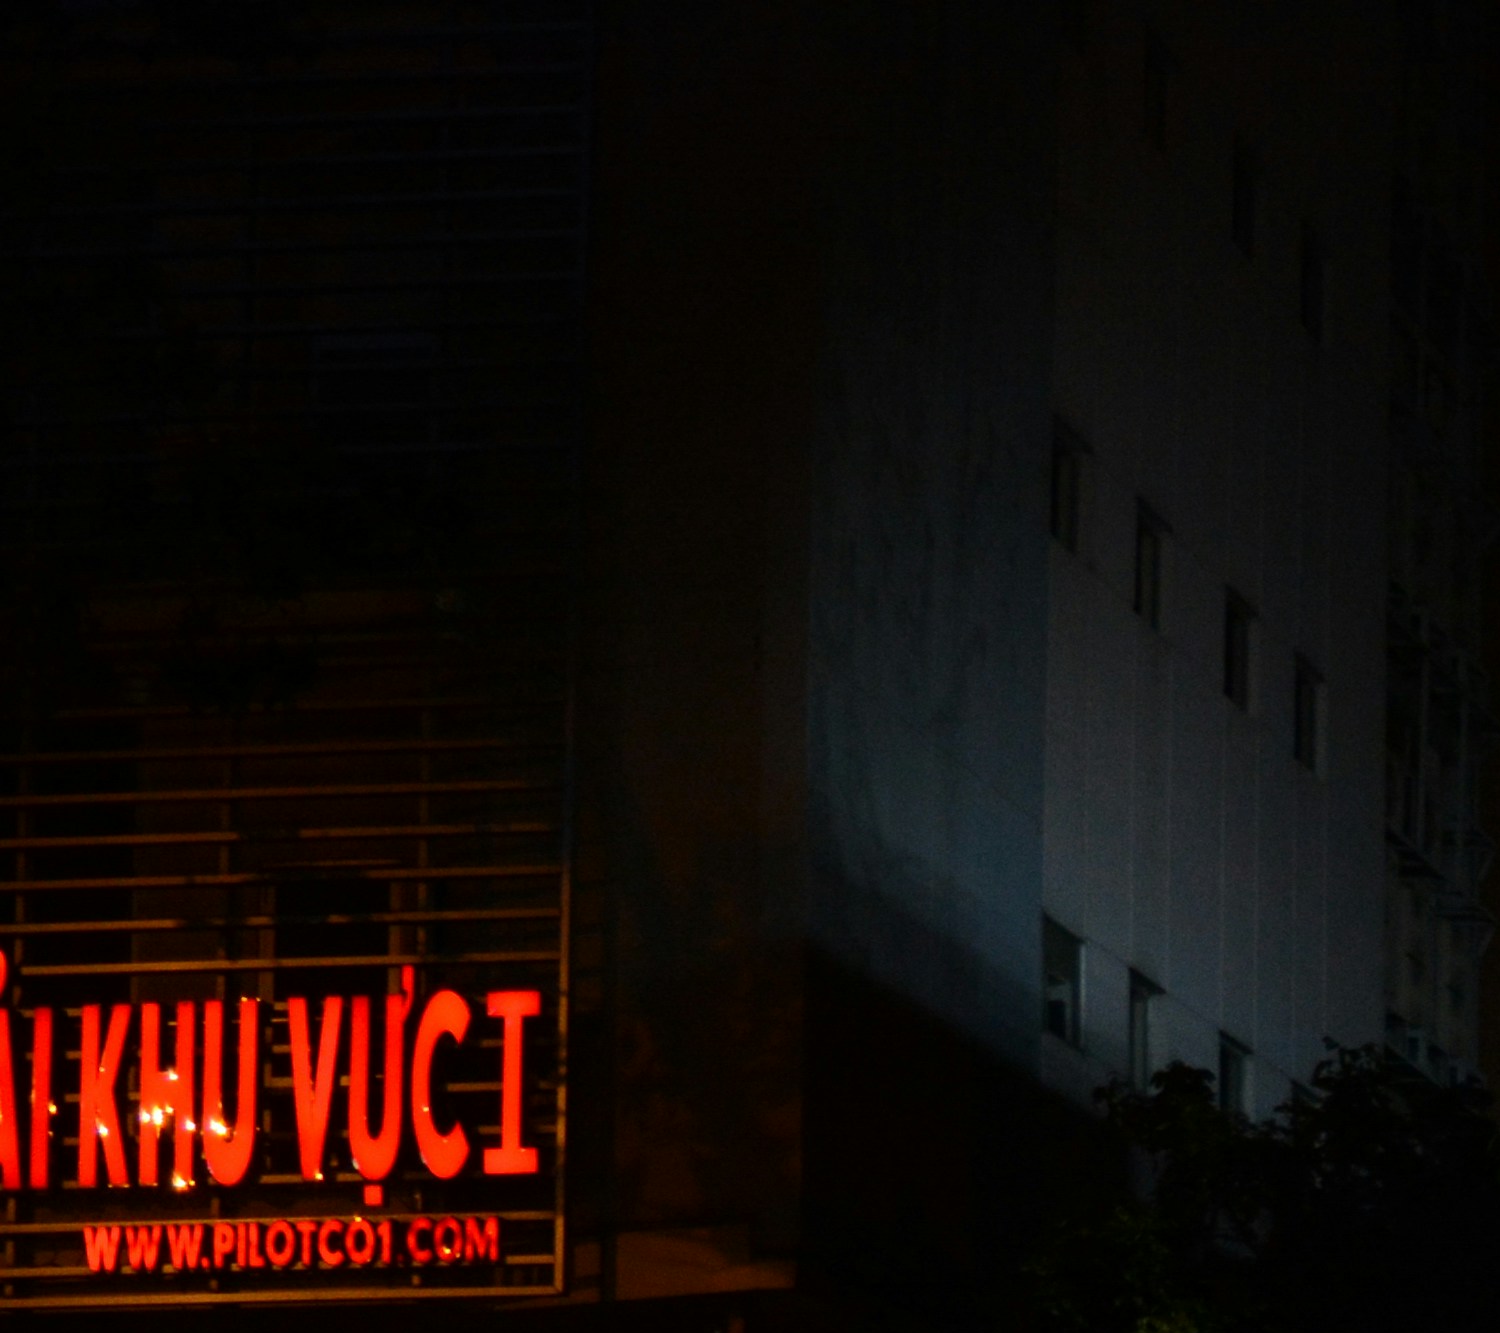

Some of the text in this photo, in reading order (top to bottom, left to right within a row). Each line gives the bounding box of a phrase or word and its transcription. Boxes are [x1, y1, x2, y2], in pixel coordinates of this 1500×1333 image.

[78, 999, 258, 1188] KHU
[287, 964, 471, 1206] VỰC
[483, 990, 541, 1175] I
